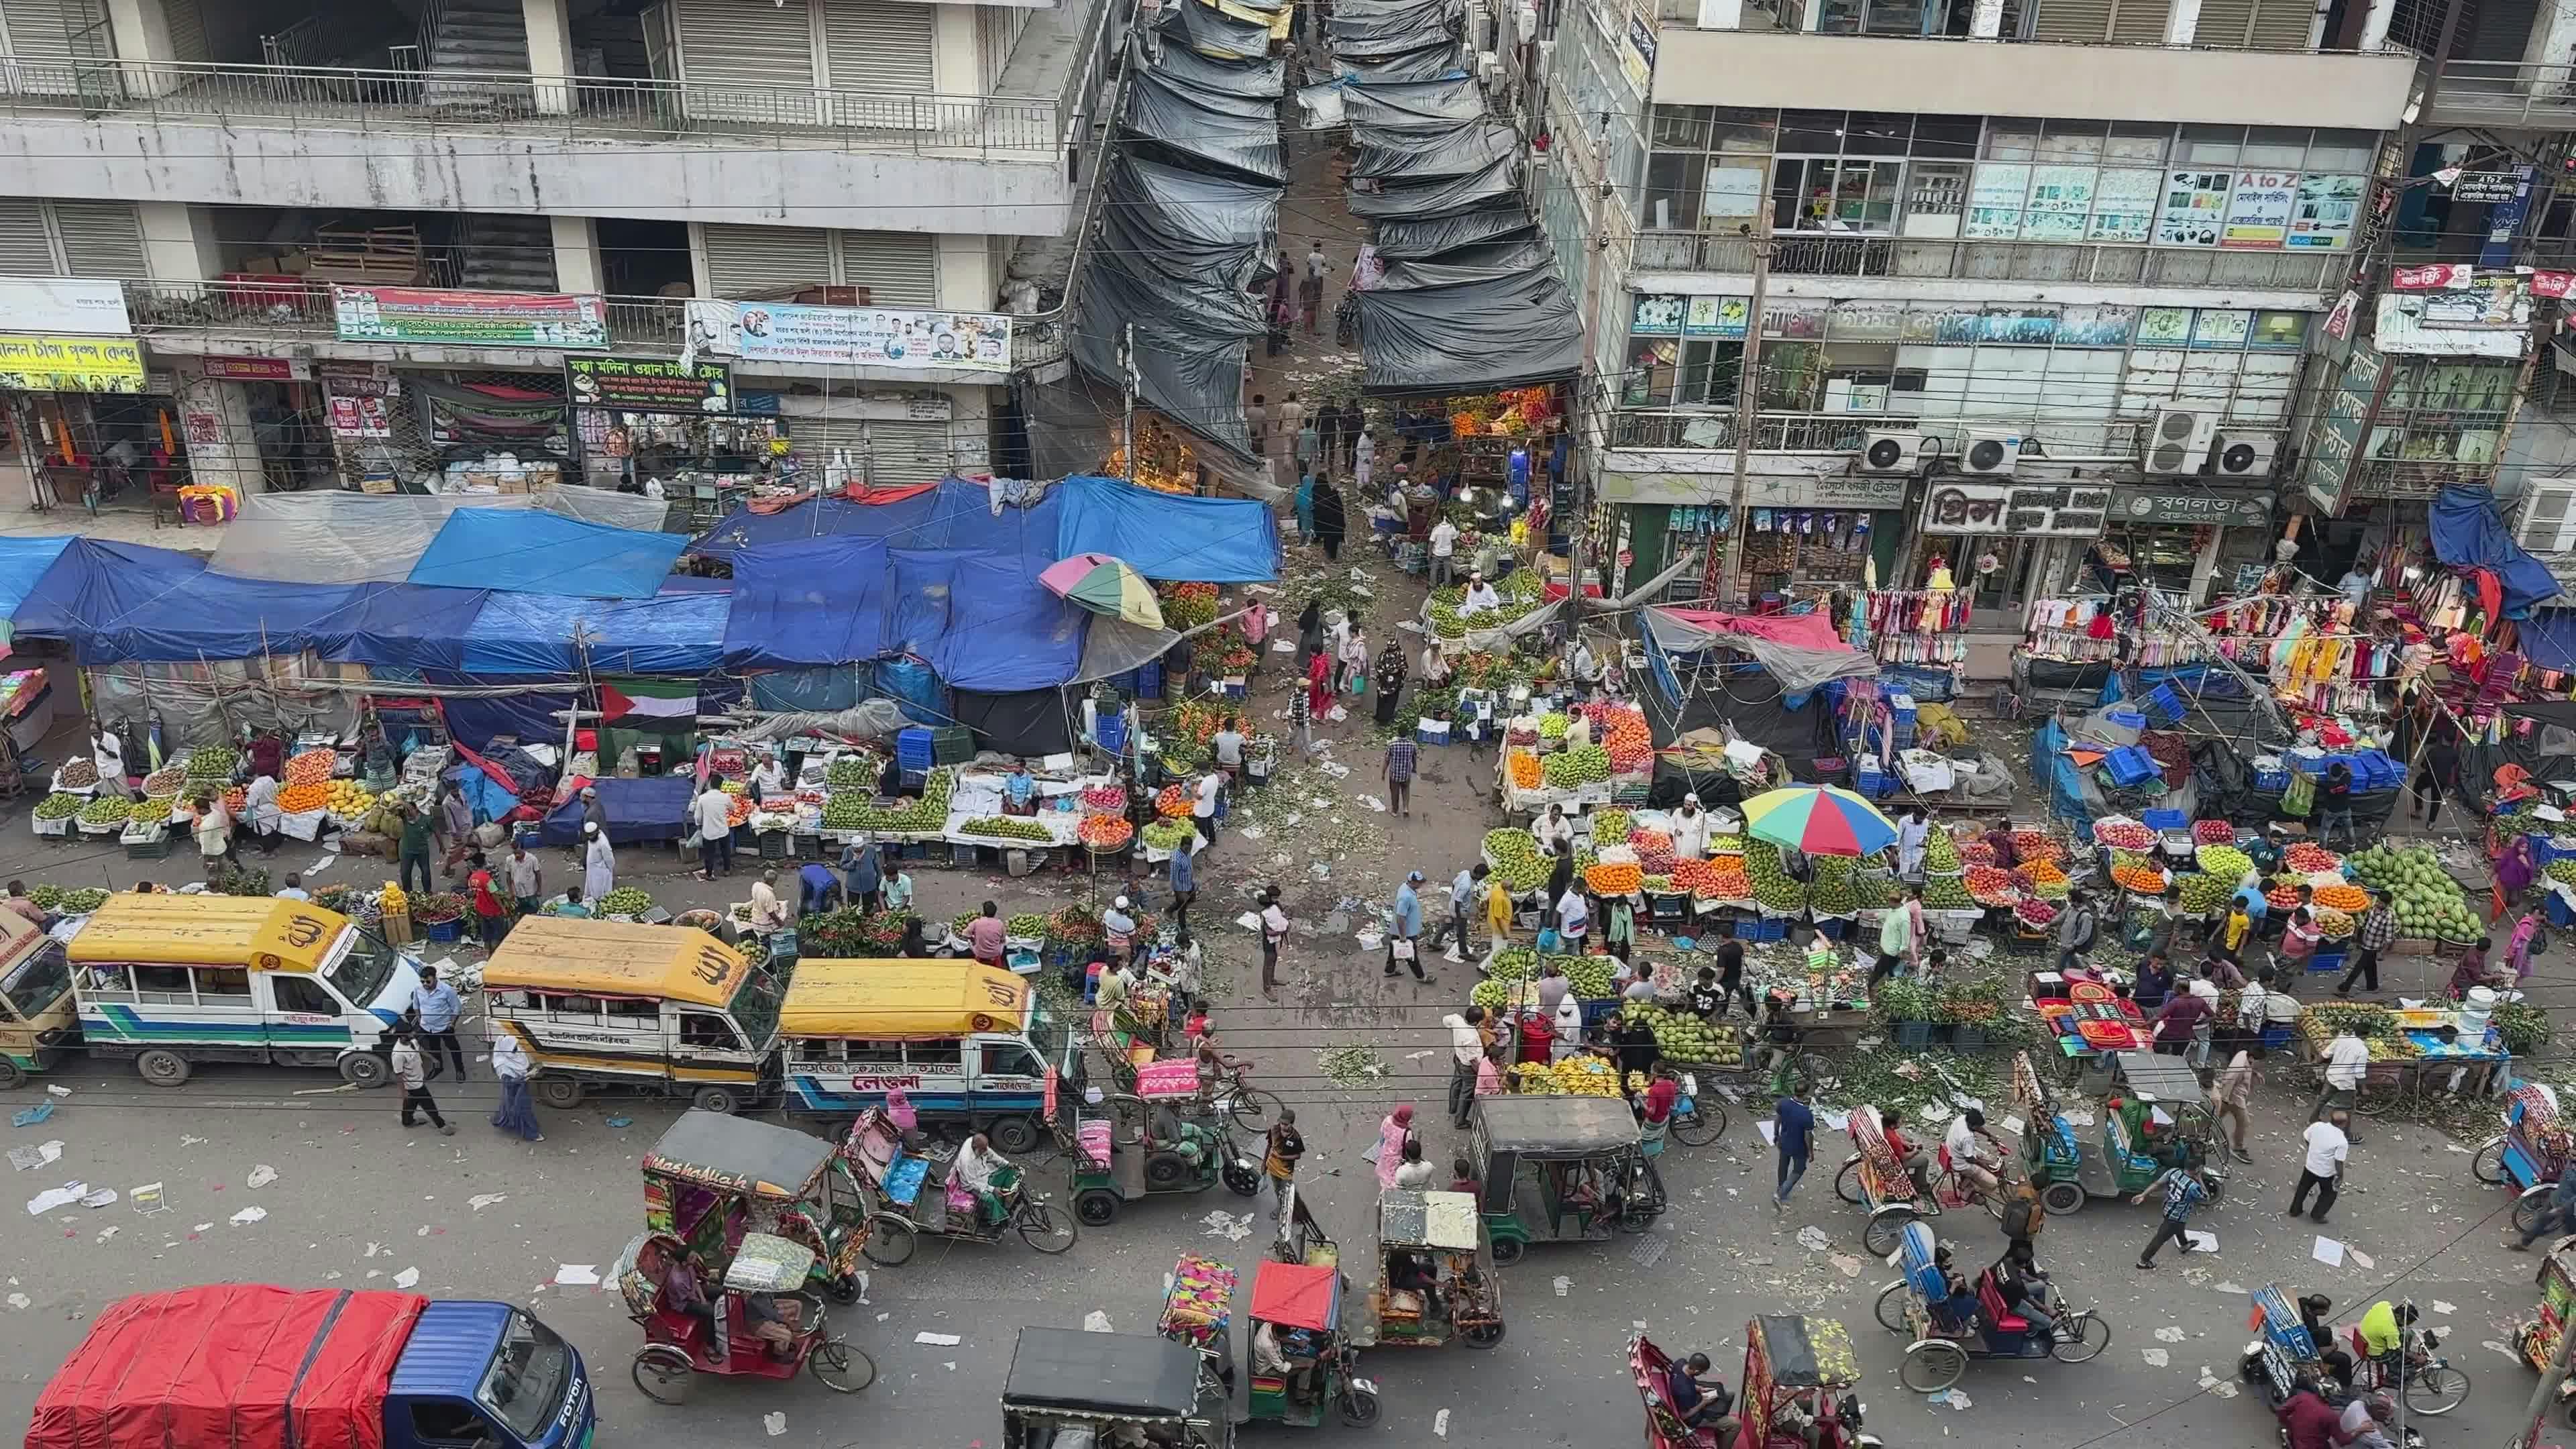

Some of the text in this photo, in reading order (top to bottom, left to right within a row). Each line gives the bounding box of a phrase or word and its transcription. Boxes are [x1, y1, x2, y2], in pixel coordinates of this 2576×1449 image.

[2239, 173, 2298, 189] A to Z
[34, 339, 64, 360] চাঁপা
[598, 359, 630, 376] মদিনা
[559, 1377, 583, 1428] FOTON
